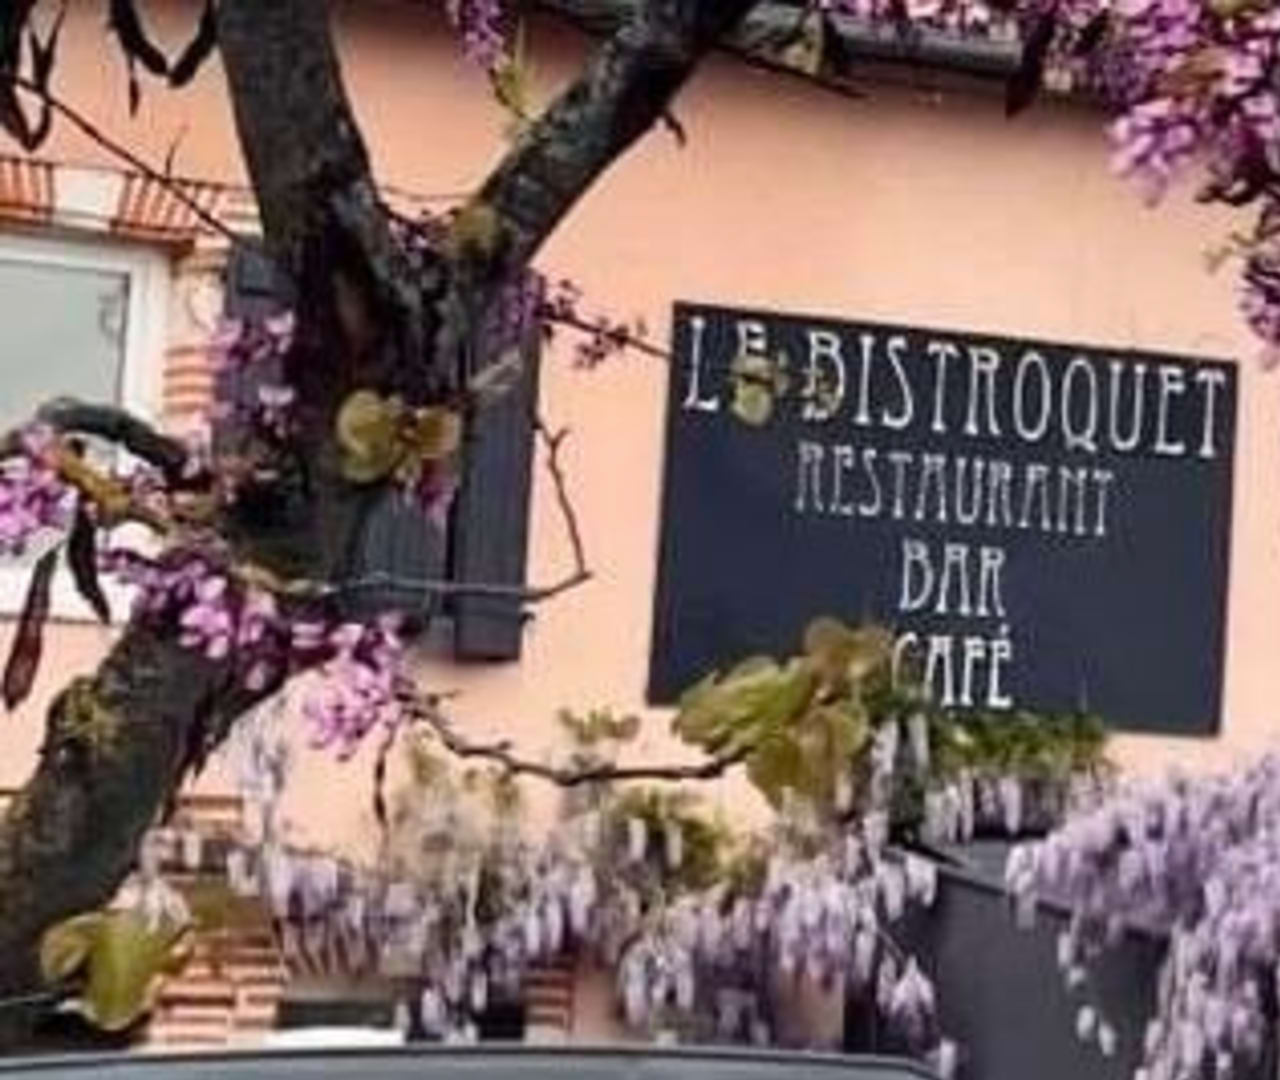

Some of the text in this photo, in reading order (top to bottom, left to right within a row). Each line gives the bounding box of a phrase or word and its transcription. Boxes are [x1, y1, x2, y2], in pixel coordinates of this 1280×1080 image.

[683, 316, 1226, 459] LE BISTROQUET
[796, 441, 1114, 536] RESTAURANT
[899, 538, 1006, 617] BAR
[891, 623, 1013, 709] CAFÉ
